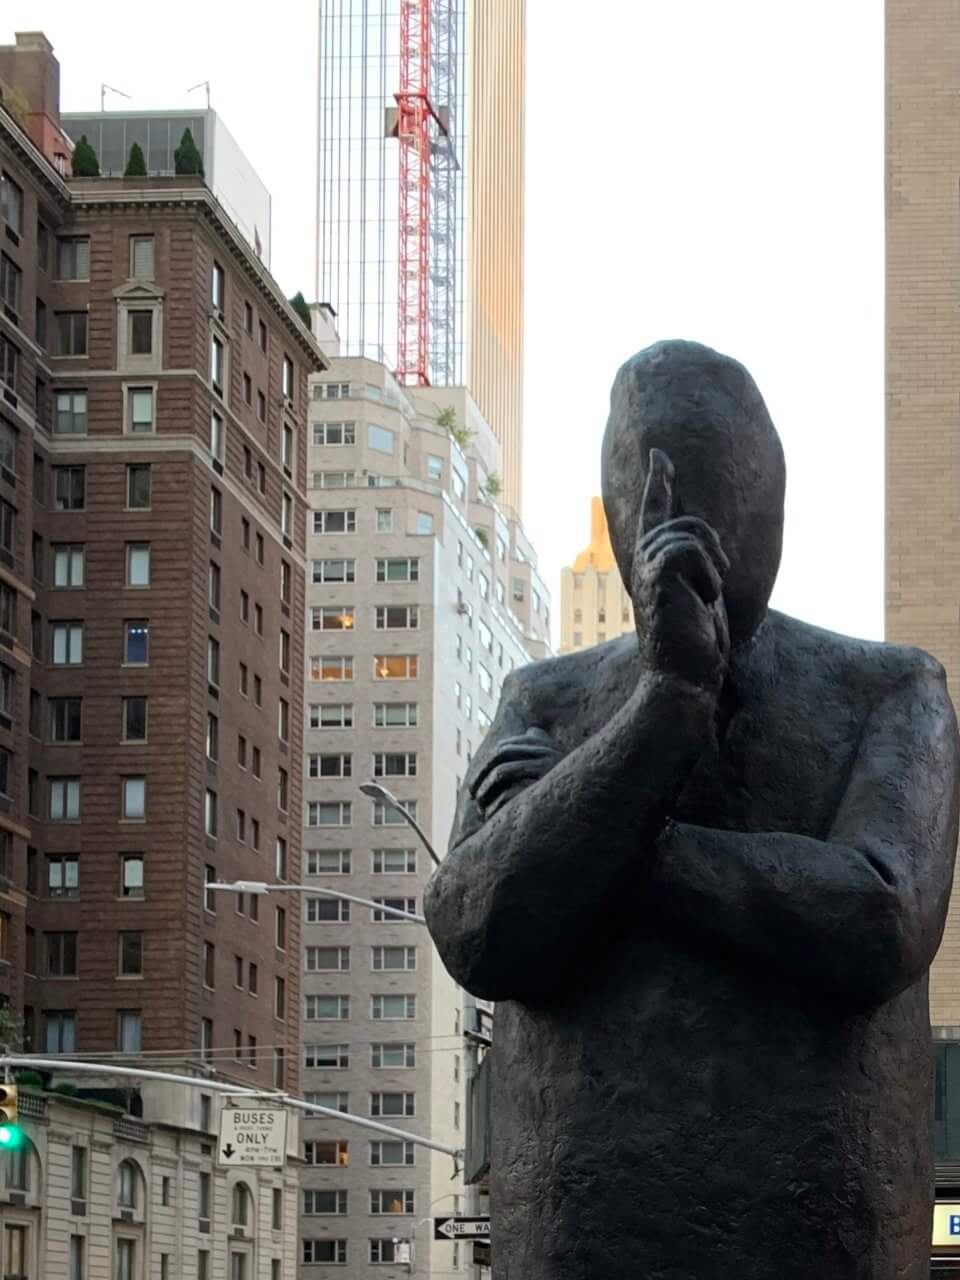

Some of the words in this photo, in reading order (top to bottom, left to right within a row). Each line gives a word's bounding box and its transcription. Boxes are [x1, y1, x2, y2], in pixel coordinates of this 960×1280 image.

[233, 1112, 275, 1124] BUSES
[236, 1132, 269, 1144] ONLY
[445, 1223, 465, 1233] ONE
[475, 1223, 490, 1233] WA
